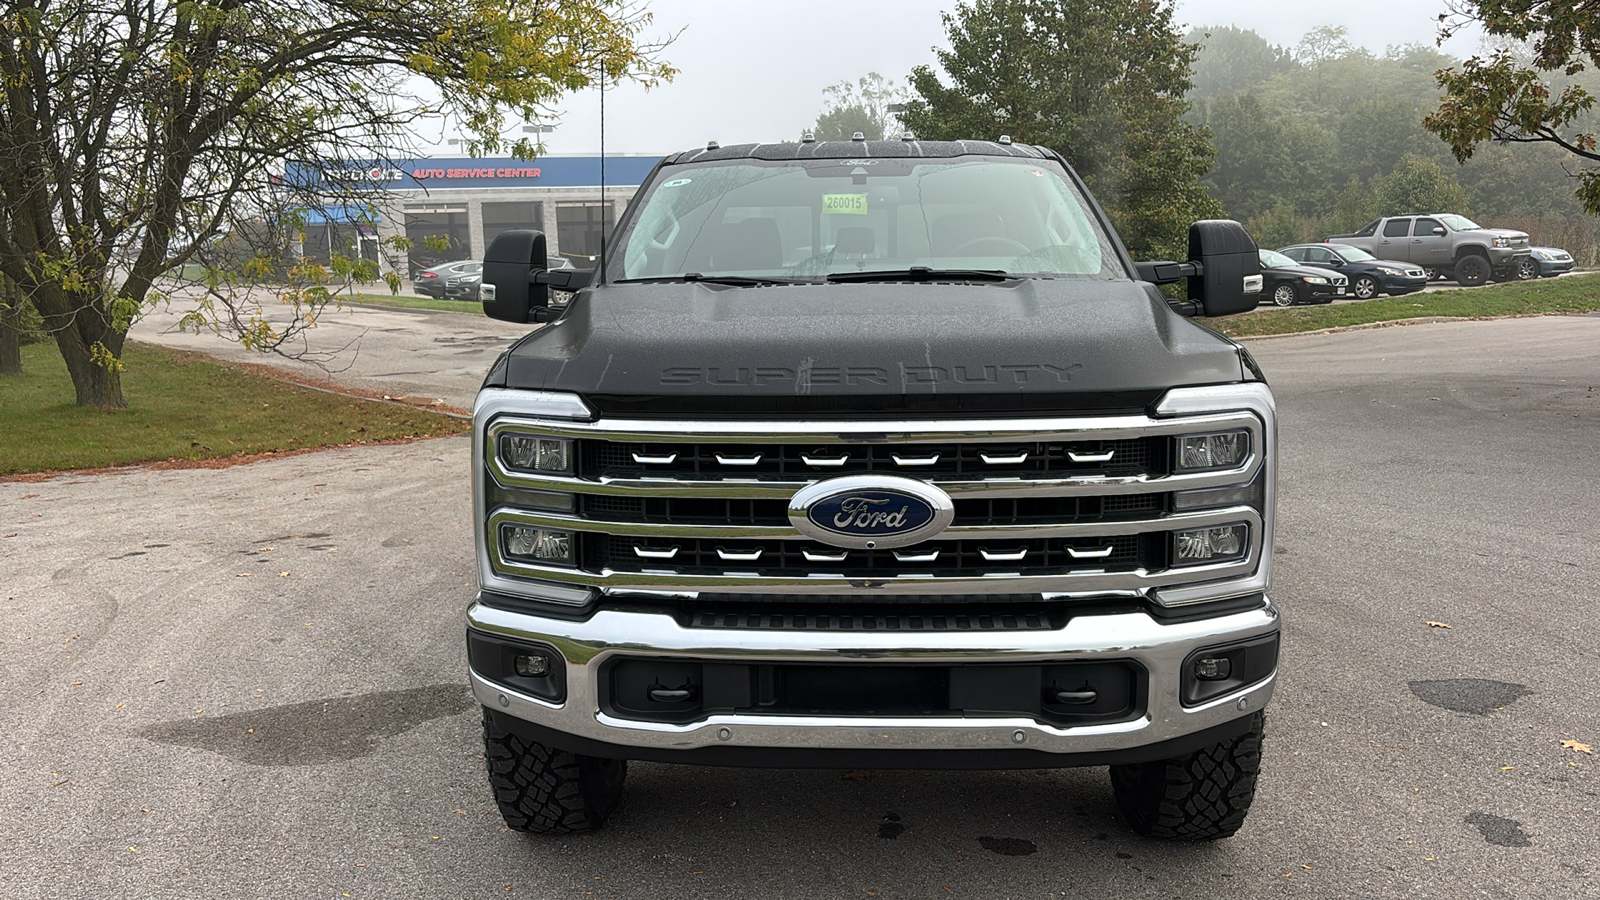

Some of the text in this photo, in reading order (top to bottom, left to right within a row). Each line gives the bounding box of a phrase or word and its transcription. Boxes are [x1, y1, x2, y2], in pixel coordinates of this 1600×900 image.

[413, 168, 445, 179] AUTO
[446, 168, 495, 179] SERVICE
[496, 167, 542, 178] CENTER
[827, 197, 862, 209] 260015
[660, 363, 1083, 386] SUPER DUTY
[833, 497, 909, 529] Ford
